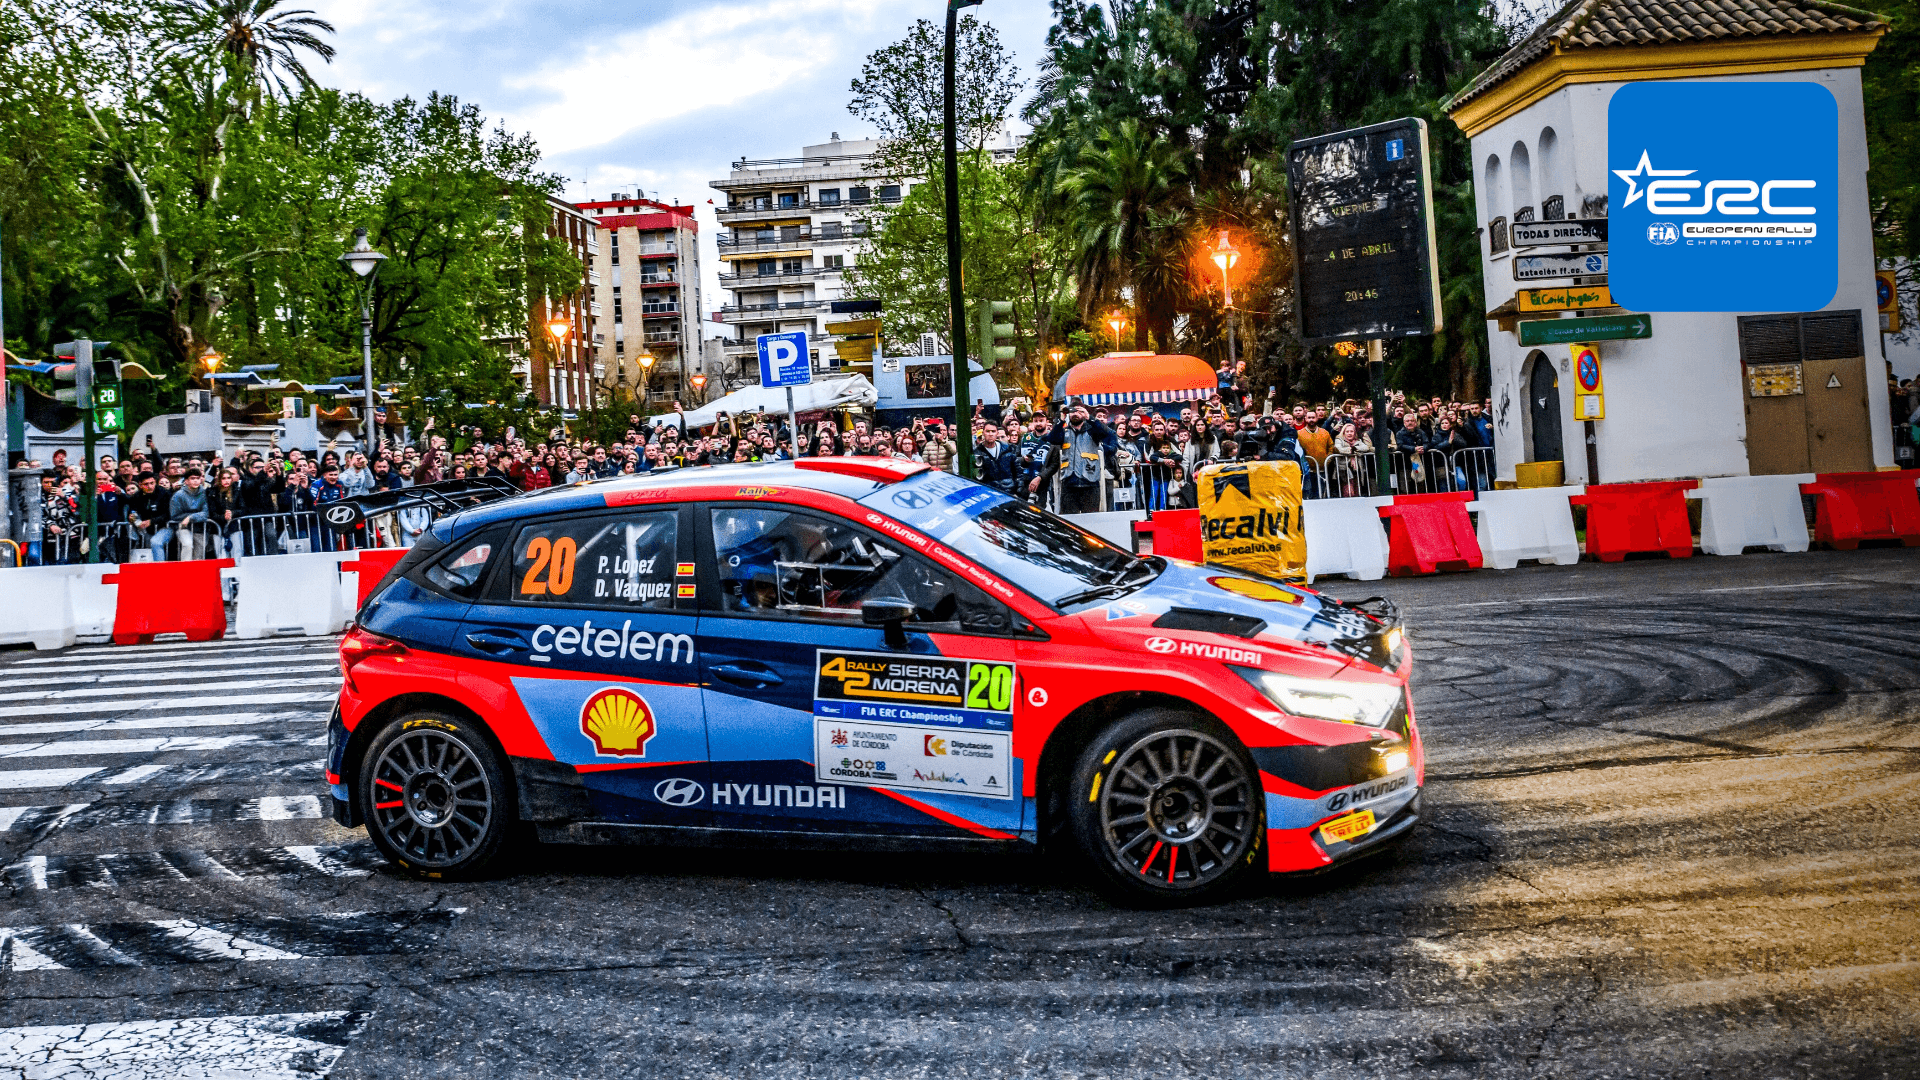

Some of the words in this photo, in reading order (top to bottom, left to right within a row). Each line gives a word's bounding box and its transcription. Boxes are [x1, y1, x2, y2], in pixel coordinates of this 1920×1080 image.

[1516, 230, 1550, 240] TODAS
[1342, 249, 1355, 258] DE
[1362, 243, 1396, 256] ABRIL
[1345, 289, 1378, 302] 20:46
[768, 340, 798, 382] P
[100, 390, 115, 402] 28
[882, 520, 927, 547] HYUNDAI
[934, 547, 970, 570] Customer
[968, 566, 994, 586] Racing
[521, 536, 576, 596] 20
[598, 555, 610, 574] P.
[614, 556, 655, 578] Lopez
[595, 578, 609, 598] D.
[614, 579, 672, 601] Vazquez
[529, 619, 695, 664] cetelem
[1181, 642, 1262, 666] HYUNDAI
[847, 661, 887, 672] RALLY
[889, 664, 960, 681] SIERRA
[873, 677, 960, 696] MORENA
[966, 664, 1012, 710] 20
[861, 706, 877, 716] FIA
[879, 708, 897, 718] ERC
[900, 709, 964, 724] Championship
[852, 731, 898, 742] AYUNTAMIENTO
[852, 740, 860, 748] DE
[951, 740, 994, 750] Diputación
[713, 782, 846, 809] HYUNDAI
[1351, 775, 1409, 803] HYUNDAI
